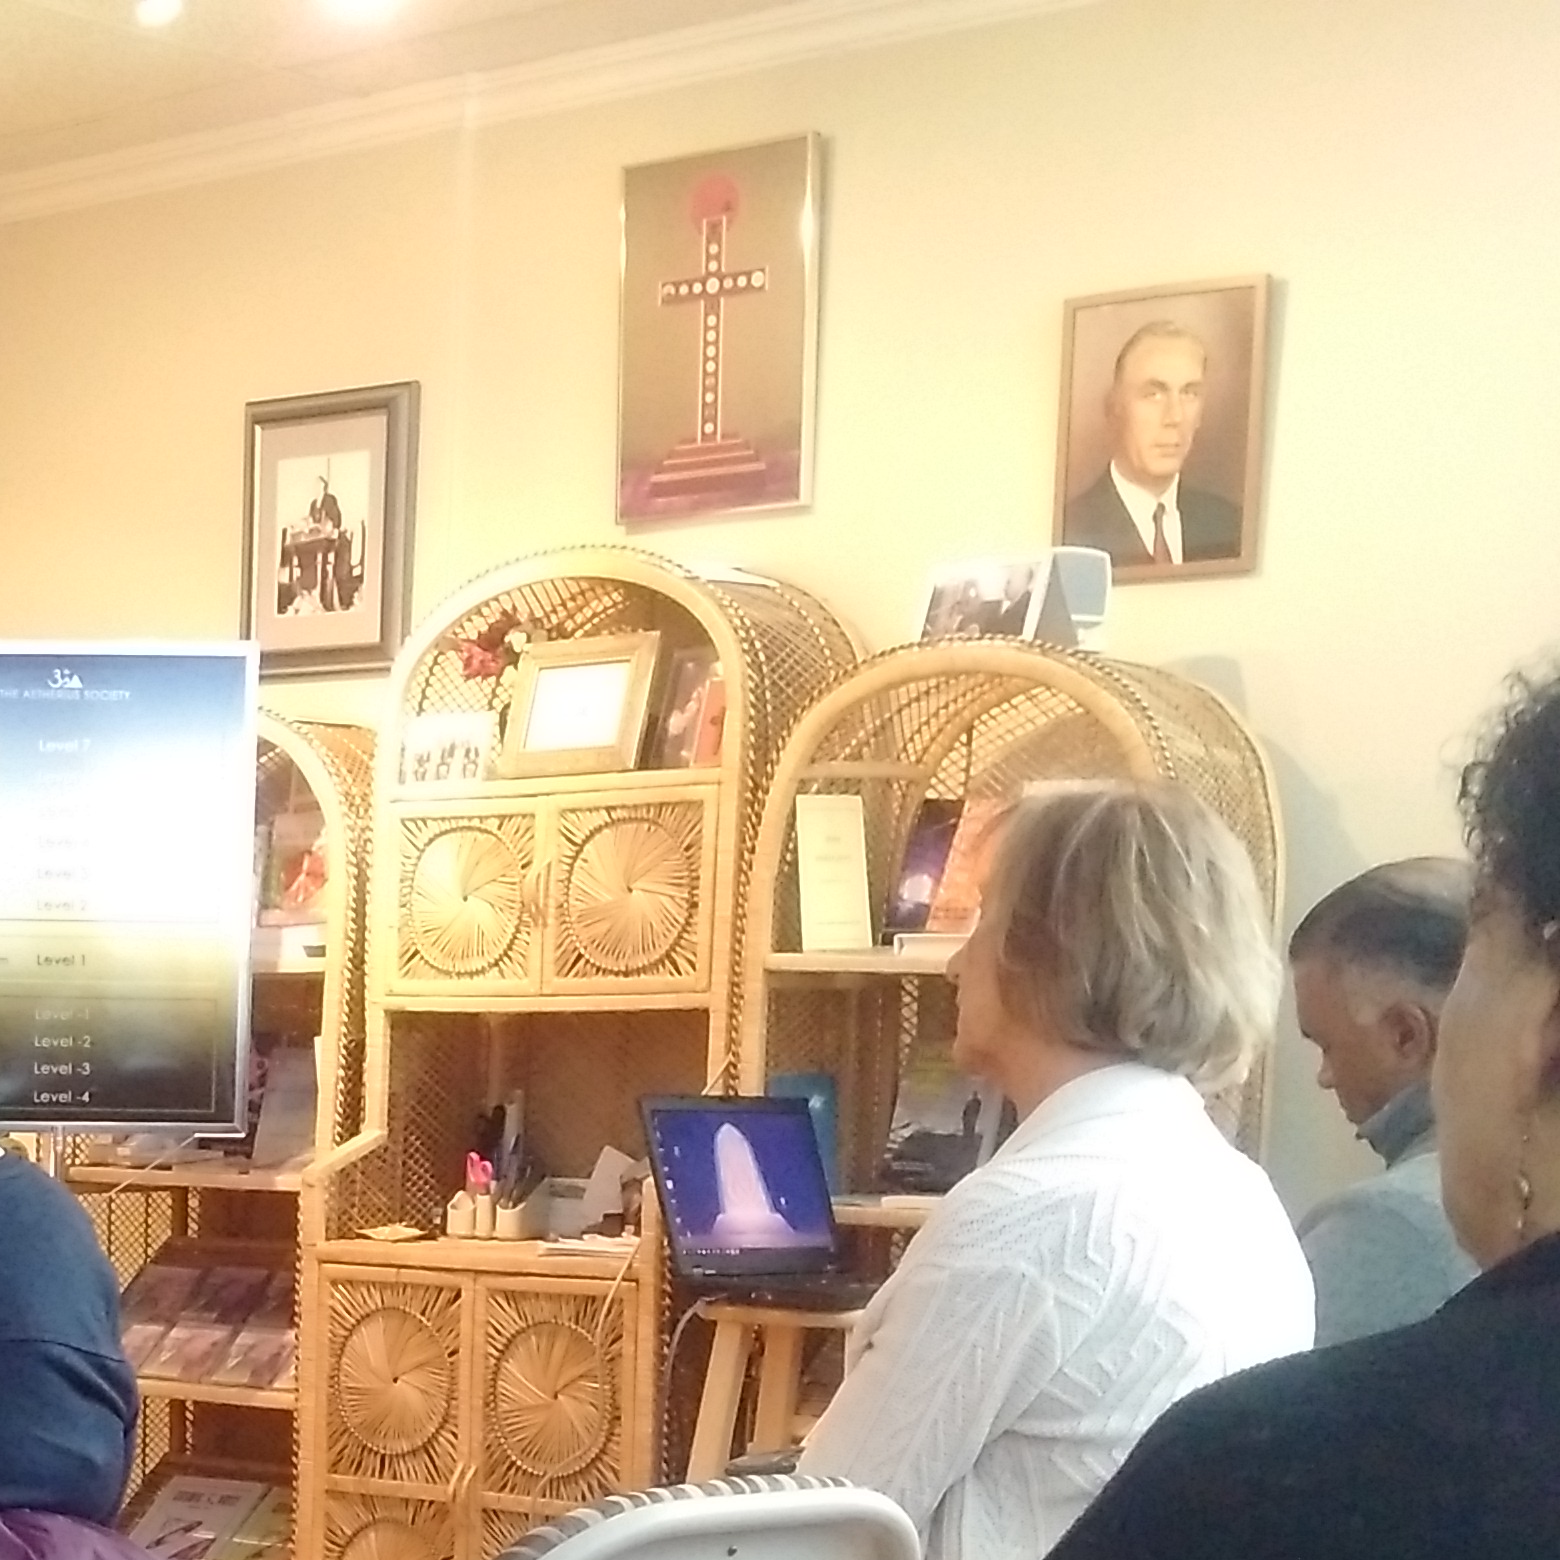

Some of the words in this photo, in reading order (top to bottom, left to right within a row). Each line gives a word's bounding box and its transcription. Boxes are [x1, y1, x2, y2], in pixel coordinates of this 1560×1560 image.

[0, 688, 19, 699] THE
[22, 689, 81, 700] AETHERIUS
[84, 690, 132, 701] SOCIETY
[38, 739, 78, 752] Level
[82, 739, 92, 752] 7
[37, 868, 76, 880] Level
[36, 899, 75, 911] Level
[79, 899, 89, 911] 2
[37, 954, 75, 966] Level
[80, 954, 87, 966] 1
[35, 1008, 73, 1021] Level
[78, 1009, 90, 1021] -1
[34, 1035, 73, 1048] Level
[77, 1035, 92, 1048] -2
[33, 1062, 72, 1075] Level
[77, 1062, 92, 1075] -3
[33, 1090, 72, 1104] Level
[76, 1091, 91, 1104] -4
